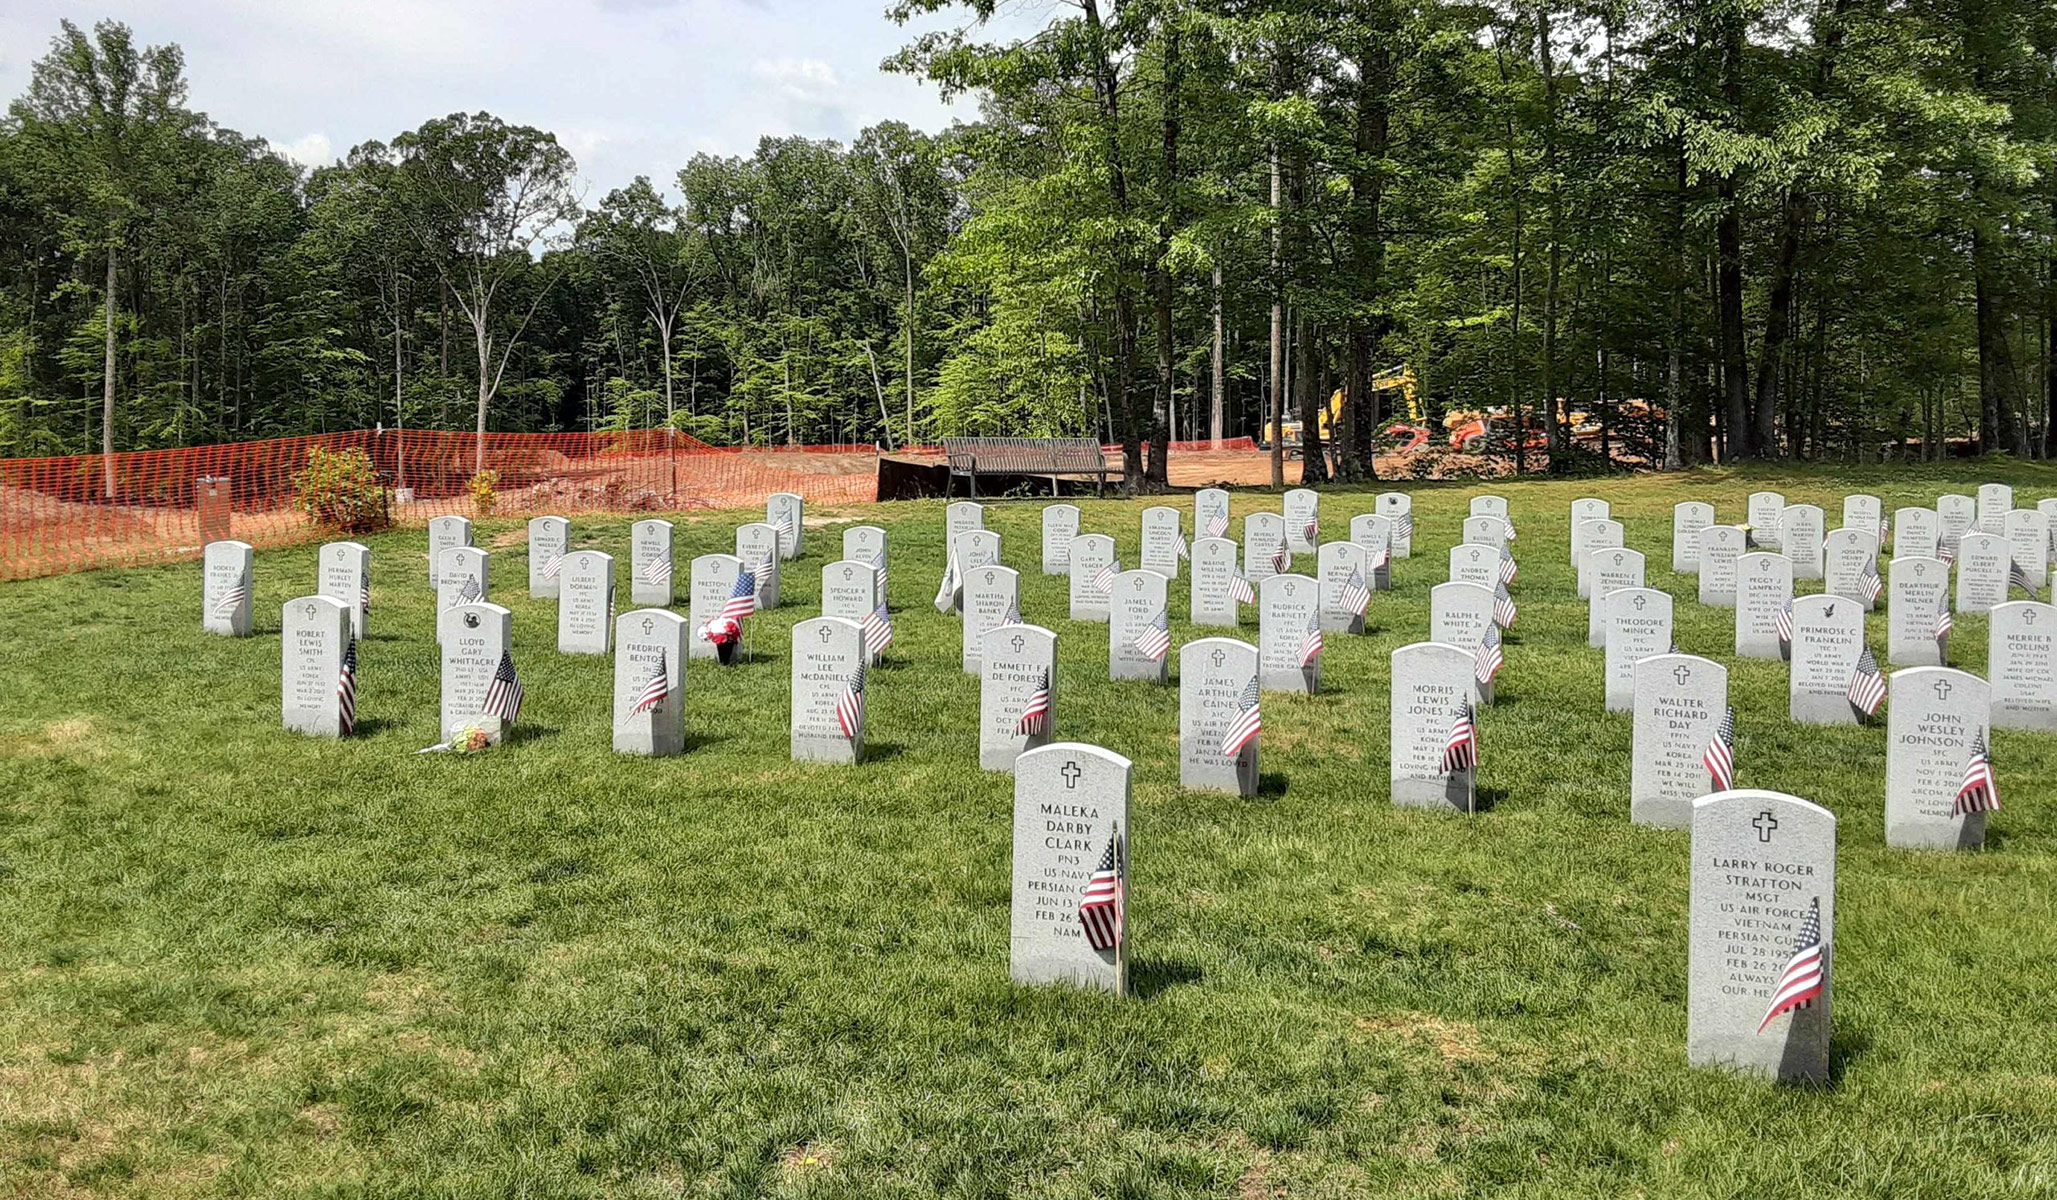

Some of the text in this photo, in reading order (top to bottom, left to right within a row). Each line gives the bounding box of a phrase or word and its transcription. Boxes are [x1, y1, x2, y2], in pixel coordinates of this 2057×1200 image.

[1128, 606, 1149, 614] FORD
[1272, 612, 1307, 620] BARNETT
[1445, 612, 1472, 620] RALPH
[1615, 618, 1665, 627] THEODORE
[296, 630, 326, 639] ROBERT
[1622, 627, 1656, 635] MINICK
[1800, 626, 1857, 636] PRIMROSE C
[299, 638, 322, 648] LEWIS
[459, 638, 485, 646] LLOYD
[1805, 636, 1852, 645] FRANKLIN
[2007, 634, 2042, 643] MERRIE
[298, 647, 323, 656] SMITH
[461, 648, 482, 656] GARY
[627, 643, 667, 654] FREDRICK
[2008, 643, 2050, 652] COLLINS
[449, 657, 496, 666] WHITTACRE
[806, 653, 845, 662] WILLIAM
[817, 663, 834, 671] LEE
[993, 662, 1032, 672] EMMETT
[992, 673, 1004, 681] DE
[1203, 678, 1235, 687] JAMES
[1198, 688, 1239, 698] ARTHUR
[1413, 685, 1454, 695] MORRIS
[1000, 695, 1009, 703] US
[1417, 696, 1450, 706] LEWIS
[1659, 696, 1704, 708] WALTER
[1203, 700, 1235, 709] CAINE
[1407, 705, 1444, 716] JONES
[1654, 708, 1708, 720] RICHARD
[1923, 712, 1962, 724] JOHN
[1669, 720, 1692, 730] DAY
[1918, 724, 1966, 736] WESLEY
[997, 727, 1010, 735] FEB
[1899, 734, 1965, 747] JOHNSON
[1413, 745, 1429, 753] MAY
[1675, 742, 1698, 750] NAVY
[1194, 748, 1210, 756] JAN
[1666, 751, 1692, 759] KOREA
[1203, 758, 1220, 766] WAS
[1221, 759, 1248, 768] LOVED
[1399, 763, 1429, 771] LOVING
[1934, 760, 1959, 768] ARMY
[1410, 772, 1455, 782] AND FATHER
[1916, 768, 1935, 776] NOV
[1676, 781, 1696, 789] WILL
[1041, 803, 1099, 819] MALEKA
[1046, 820, 1093, 835] DARBY
[1045, 836, 1093, 852] CLARK
[1058, 855, 1080, 865] PN3
[1713, 858, 1814, 877] LARRY ROGER
[1044, 869, 1057, 878] US
[1028, 881, 1074, 893] PERSIAN
[1726, 875, 1802, 890] STRATTON
[1035, 896, 1058, 907] JUN
[1746, 893, 1780, 903] MSGT
[1035, 910, 1055, 921] FEB
[1059, 911, 1072, 922] 26
[1720, 903, 1806, 919] US AIR FORCE
[1734, 918, 1792, 931] VIETNAM
[1718, 930, 1769, 943] PERSIAN
[1725, 945, 1766, 957] JUL 28
[1726, 958, 1766, 970] FEB 26
[1729, 973, 1776, 985] ALWAYS
[1721, 985, 1748, 995] OUR
